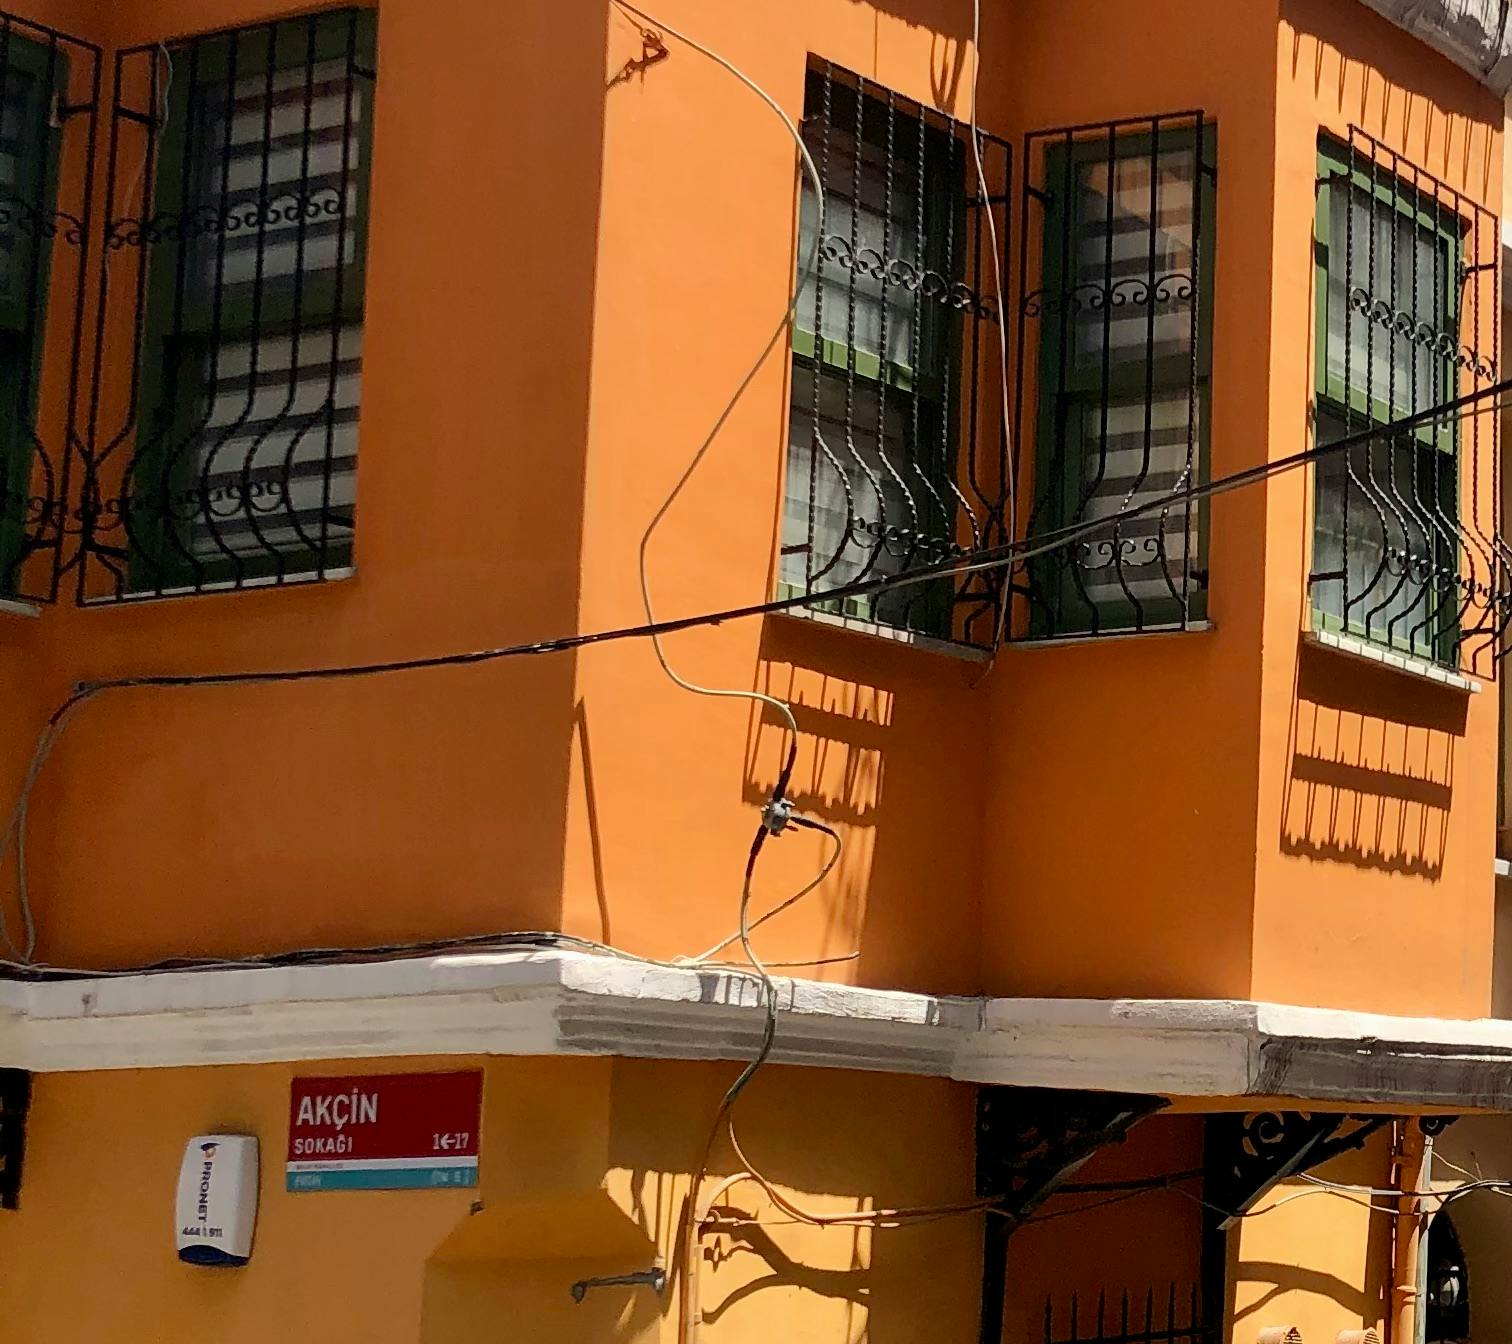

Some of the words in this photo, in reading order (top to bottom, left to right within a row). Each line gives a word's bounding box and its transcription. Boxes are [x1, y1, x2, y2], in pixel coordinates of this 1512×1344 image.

[296, 1088, 378, 1130] AKÇİN
[294, 1134, 353, 1154] SOKAĞI
[198, 1161, 213, 1223] PRONET
